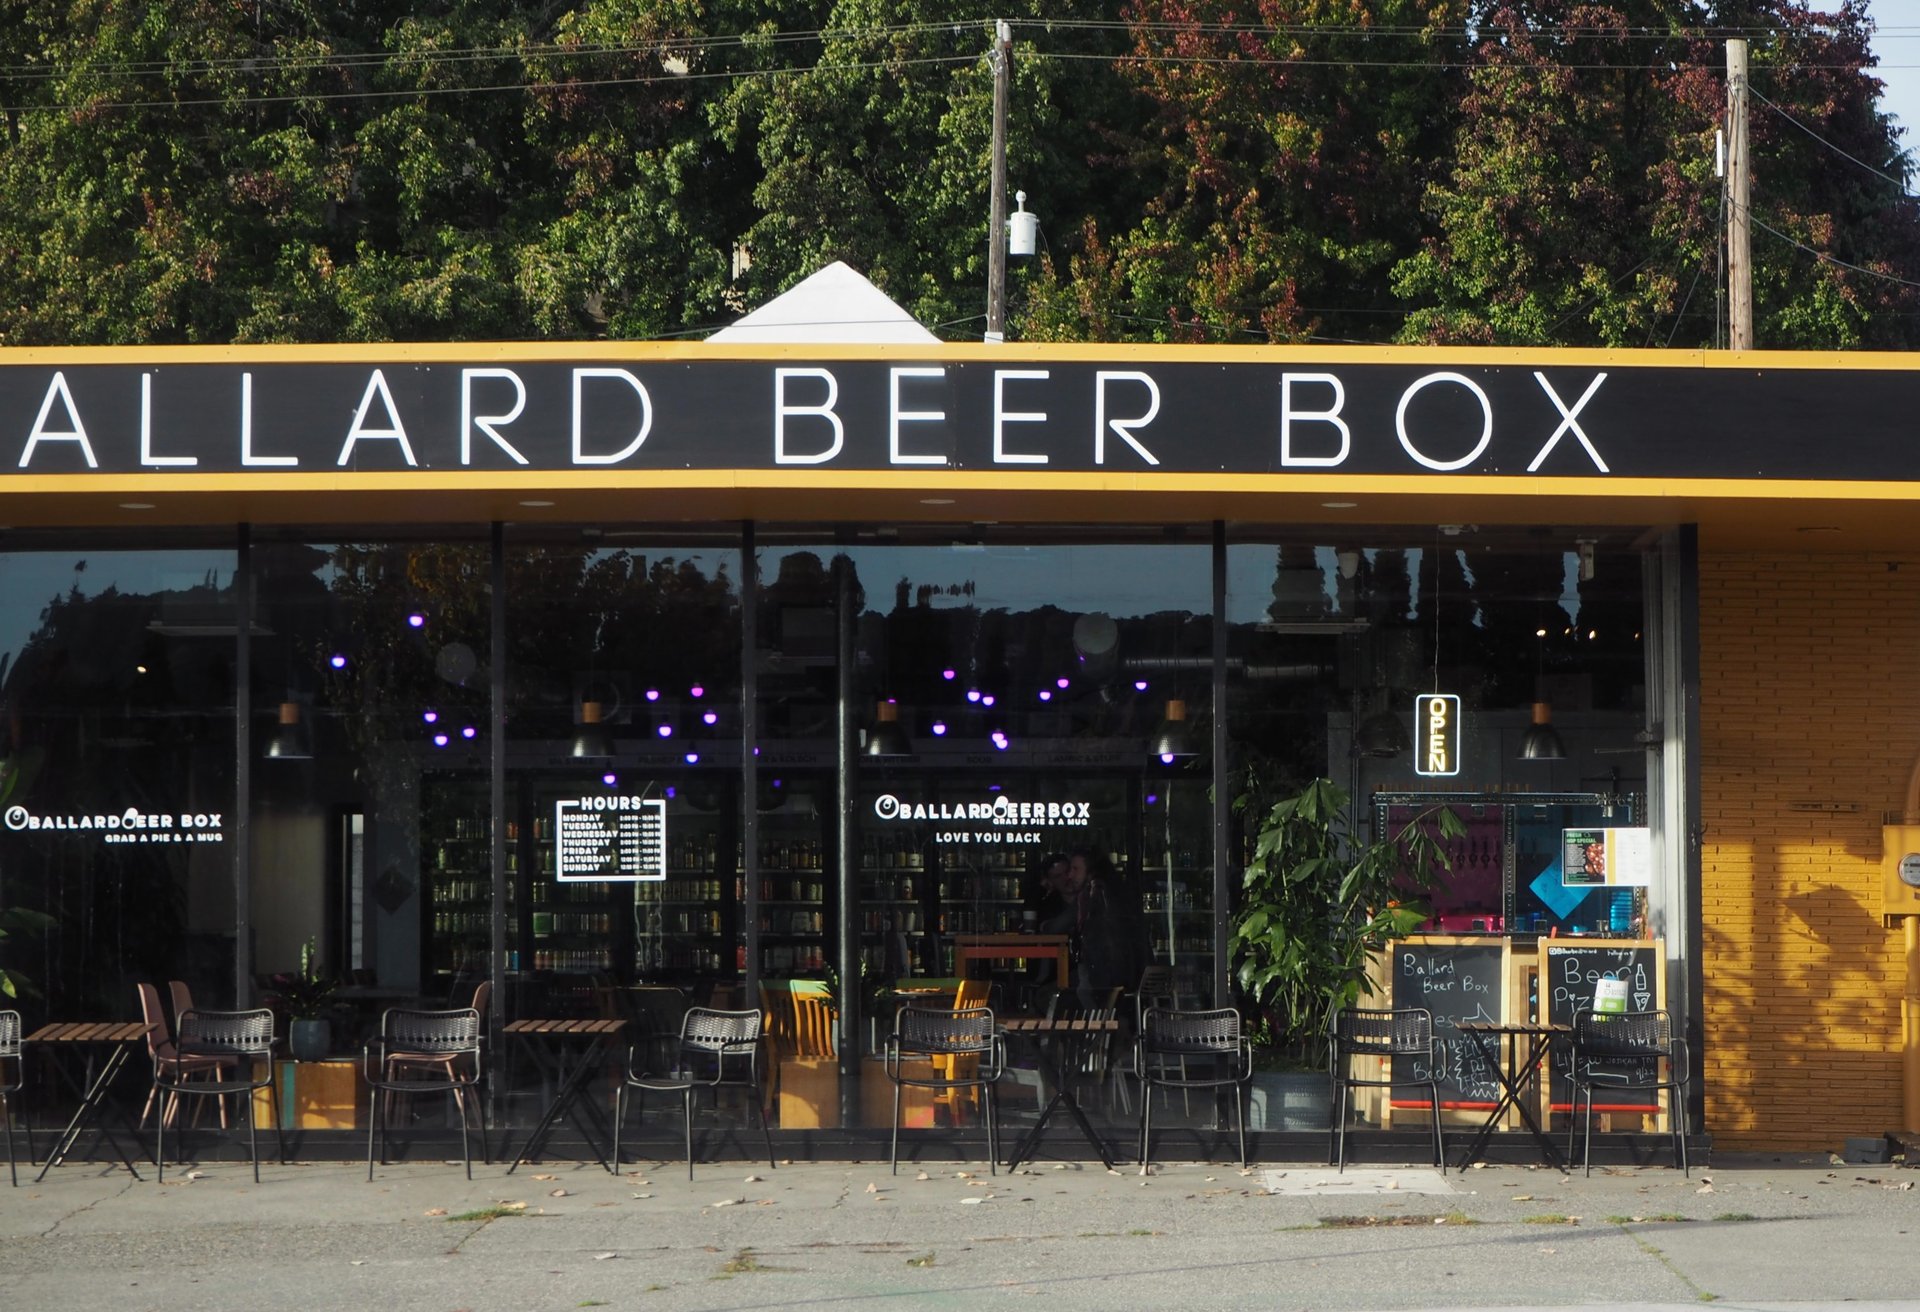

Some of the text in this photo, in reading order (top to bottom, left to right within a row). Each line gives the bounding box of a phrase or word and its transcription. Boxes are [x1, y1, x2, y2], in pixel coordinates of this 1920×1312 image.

[775, 366, 1160, 466] BEER
[1275, 370, 1609, 476] BOX
[1429, 698, 1446, 772] OPEN
[582, 796, 641, 810] HOURS
[181, 814, 221, 827] BOX
[1067, 818, 1088, 826] MUG
[105, 834, 136, 842] GRAB
[152, 834, 170, 842] PIE
[198, 833, 222, 841] MUG
[563, 830, 618, 838] WEDNESDAY
[936, 833, 1040, 842] LOVE YOU BACK
[562, 855, 611, 864] SATURDAY
[562, 863, 600, 871] SUNDAY
[1403, 953, 1455, 977] Ballard
[1423, 975, 1489, 994] Beer Box
